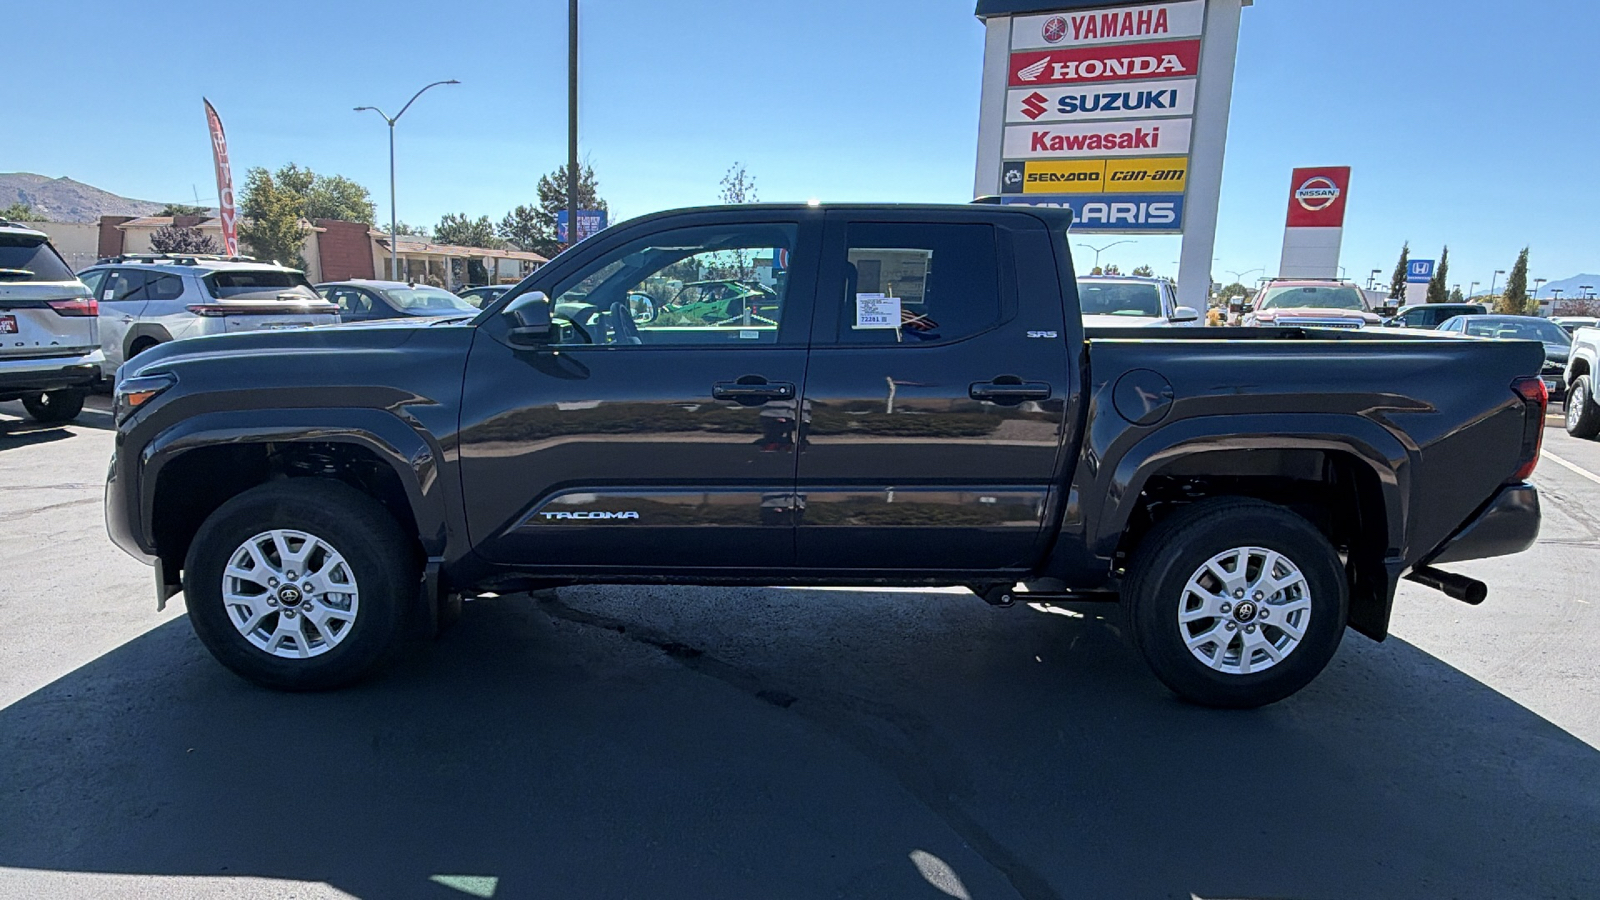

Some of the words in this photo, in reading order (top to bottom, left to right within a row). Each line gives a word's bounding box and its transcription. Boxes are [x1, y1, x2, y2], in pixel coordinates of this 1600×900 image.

[1071, 8, 1168, 40] YAMAHA
[1050, 54, 1186, 80] HONDA
[1057, 89, 1178, 114] SUZUKI
[1031, 127, 1160, 152] Kawasaki
[1299, 189, 1336, 198] NISSAN
[1026, 330, 1058, 338] SR5
[540, 511, 640, 520] TACOMA
